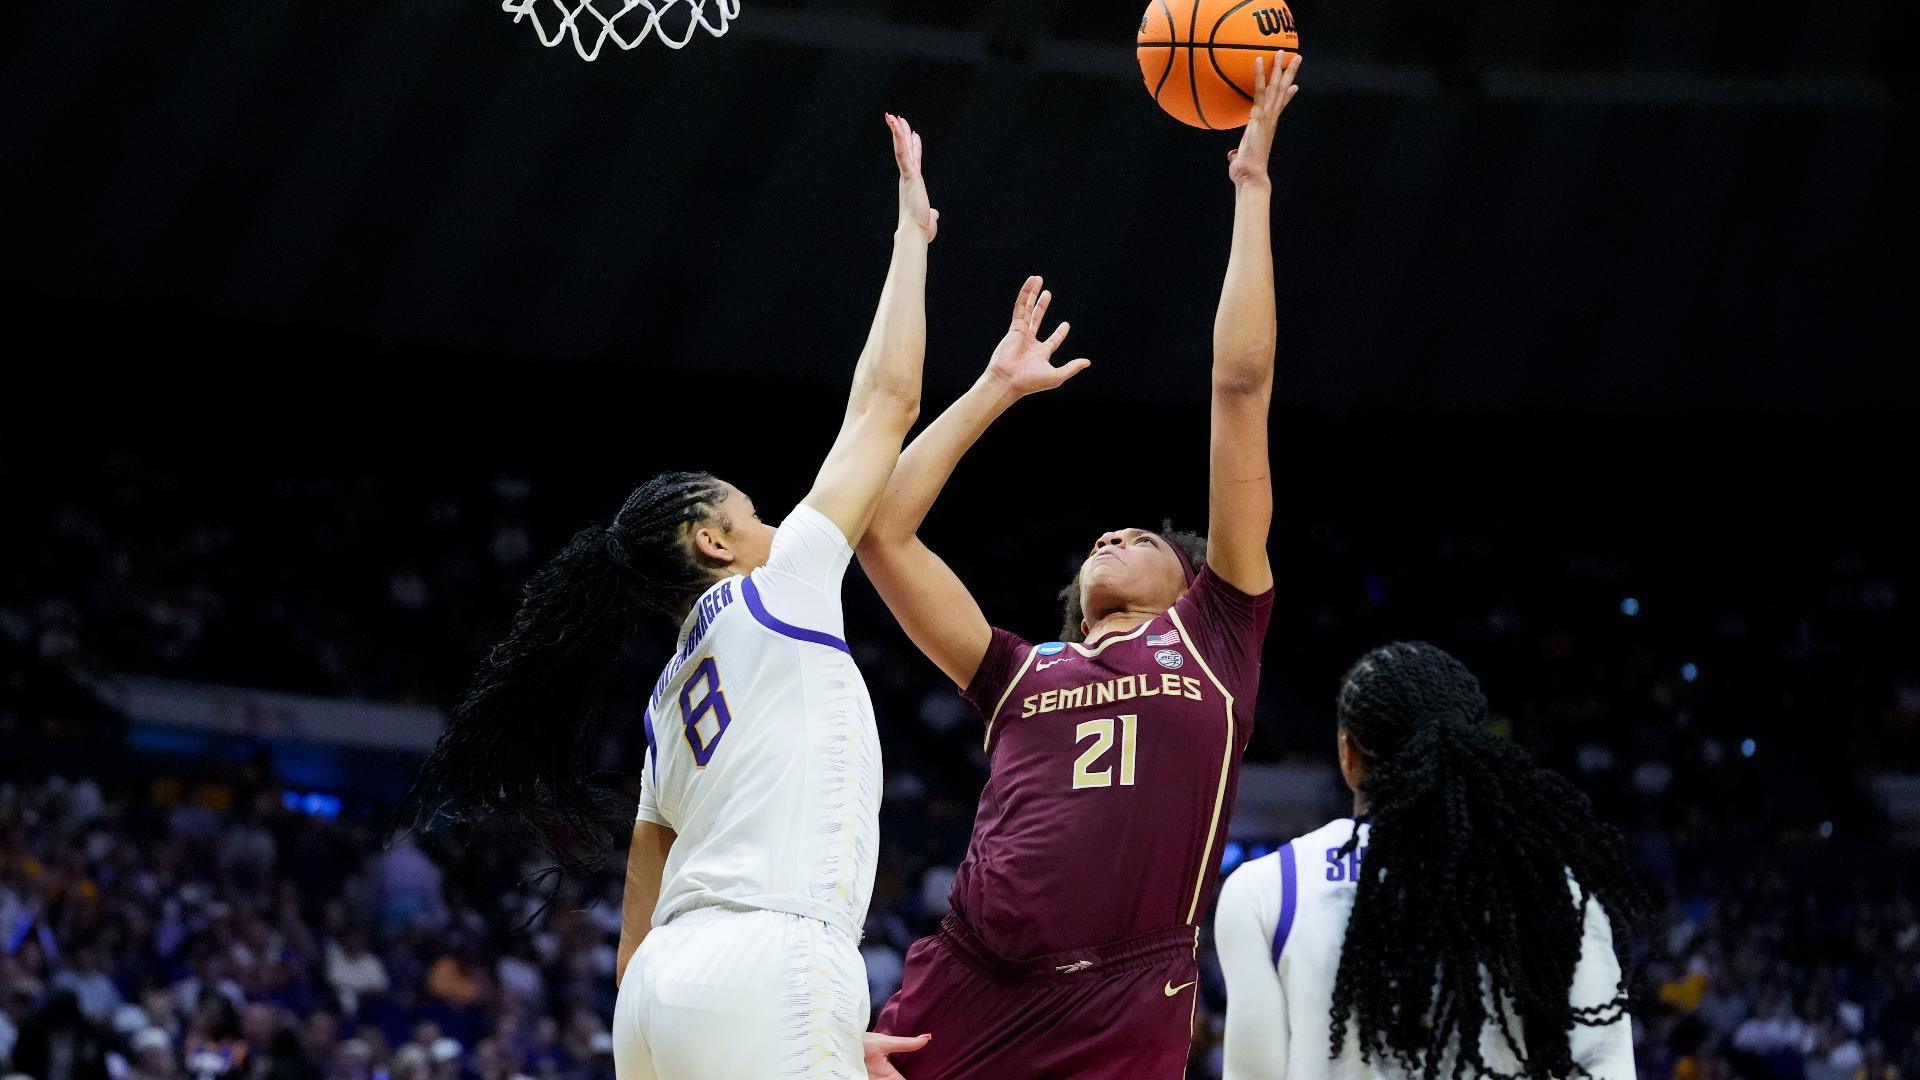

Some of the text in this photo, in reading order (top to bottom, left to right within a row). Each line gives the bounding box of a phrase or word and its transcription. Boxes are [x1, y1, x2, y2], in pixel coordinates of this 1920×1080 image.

[678, 656, 733, 769] 8
[1021, 673, 1203, 718] SEMINOLES
[1072, 714, 1138, 790] 21
[1326, 846, 1368, 882] SH
